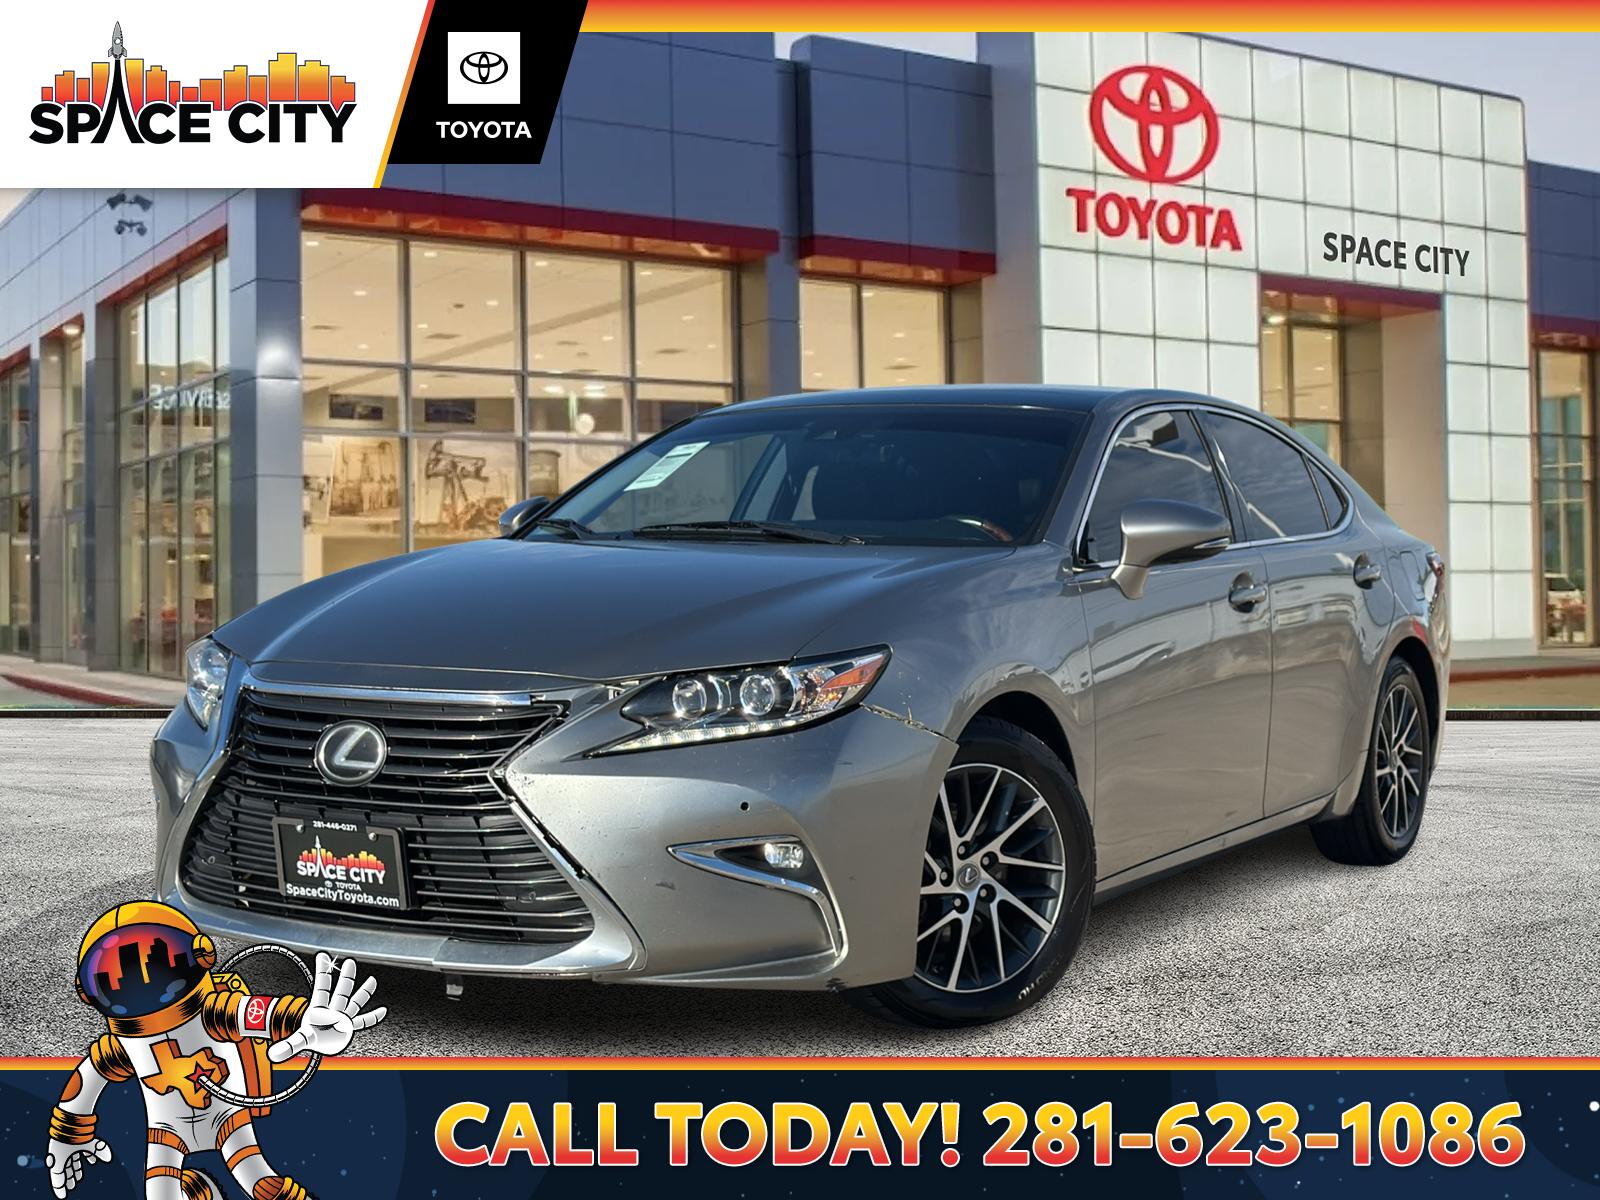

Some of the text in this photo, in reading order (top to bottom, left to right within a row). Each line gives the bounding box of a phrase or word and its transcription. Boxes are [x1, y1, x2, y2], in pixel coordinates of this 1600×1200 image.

[1066, 188, 1243, 251] TOYOTA
[1323, 232, 1470, 277] SPACE CITY
[334, 881, 362, 892] TOYOTA
[349, 867, 386, 885] CITY
[286, 883, 400, 908] SpaceCityToyota.com
